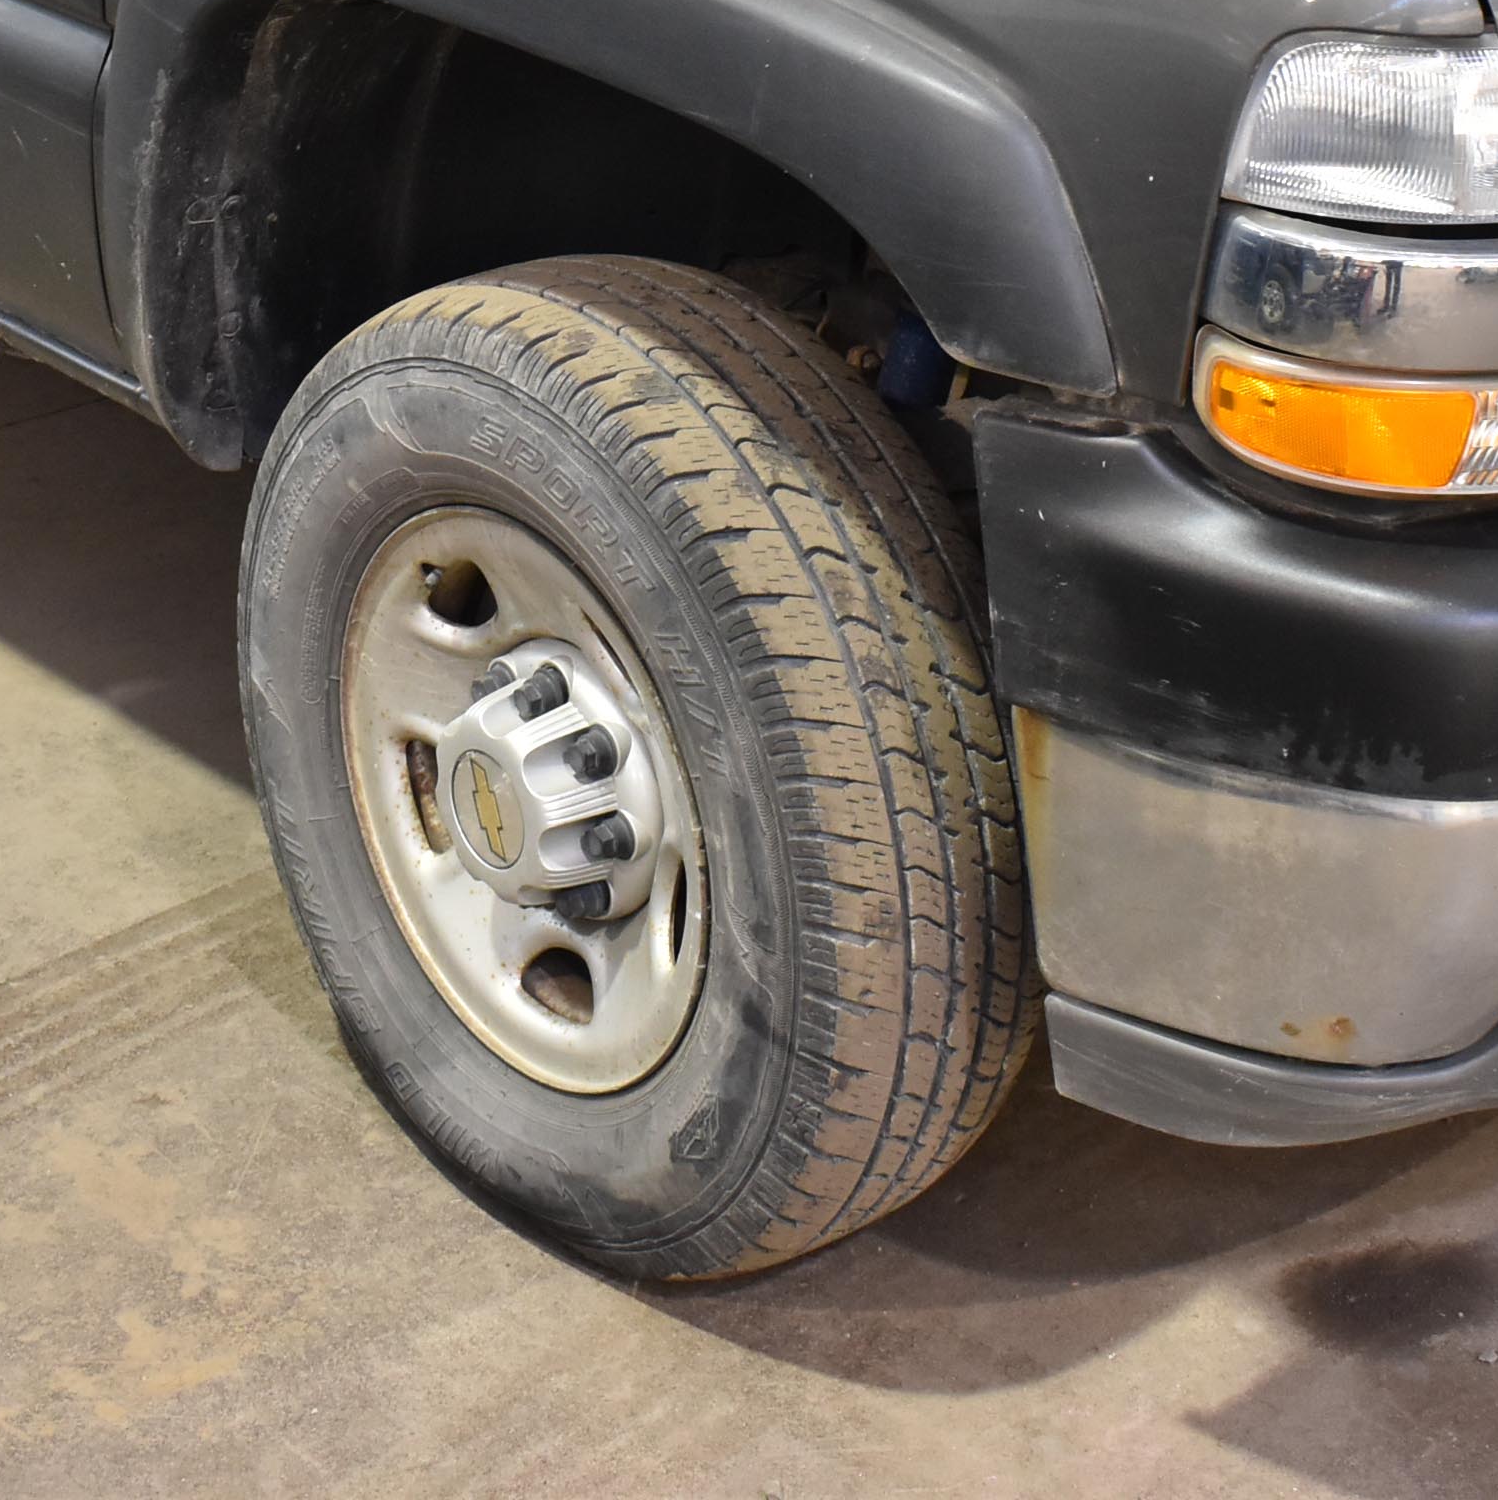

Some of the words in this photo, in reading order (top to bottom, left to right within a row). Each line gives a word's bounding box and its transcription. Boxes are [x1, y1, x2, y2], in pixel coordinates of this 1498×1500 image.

[469, 416, 659, 593] SPORT
[265, 776, 381, 1034] SPIRIT
[385, 1062, 500, 1174] WILD
